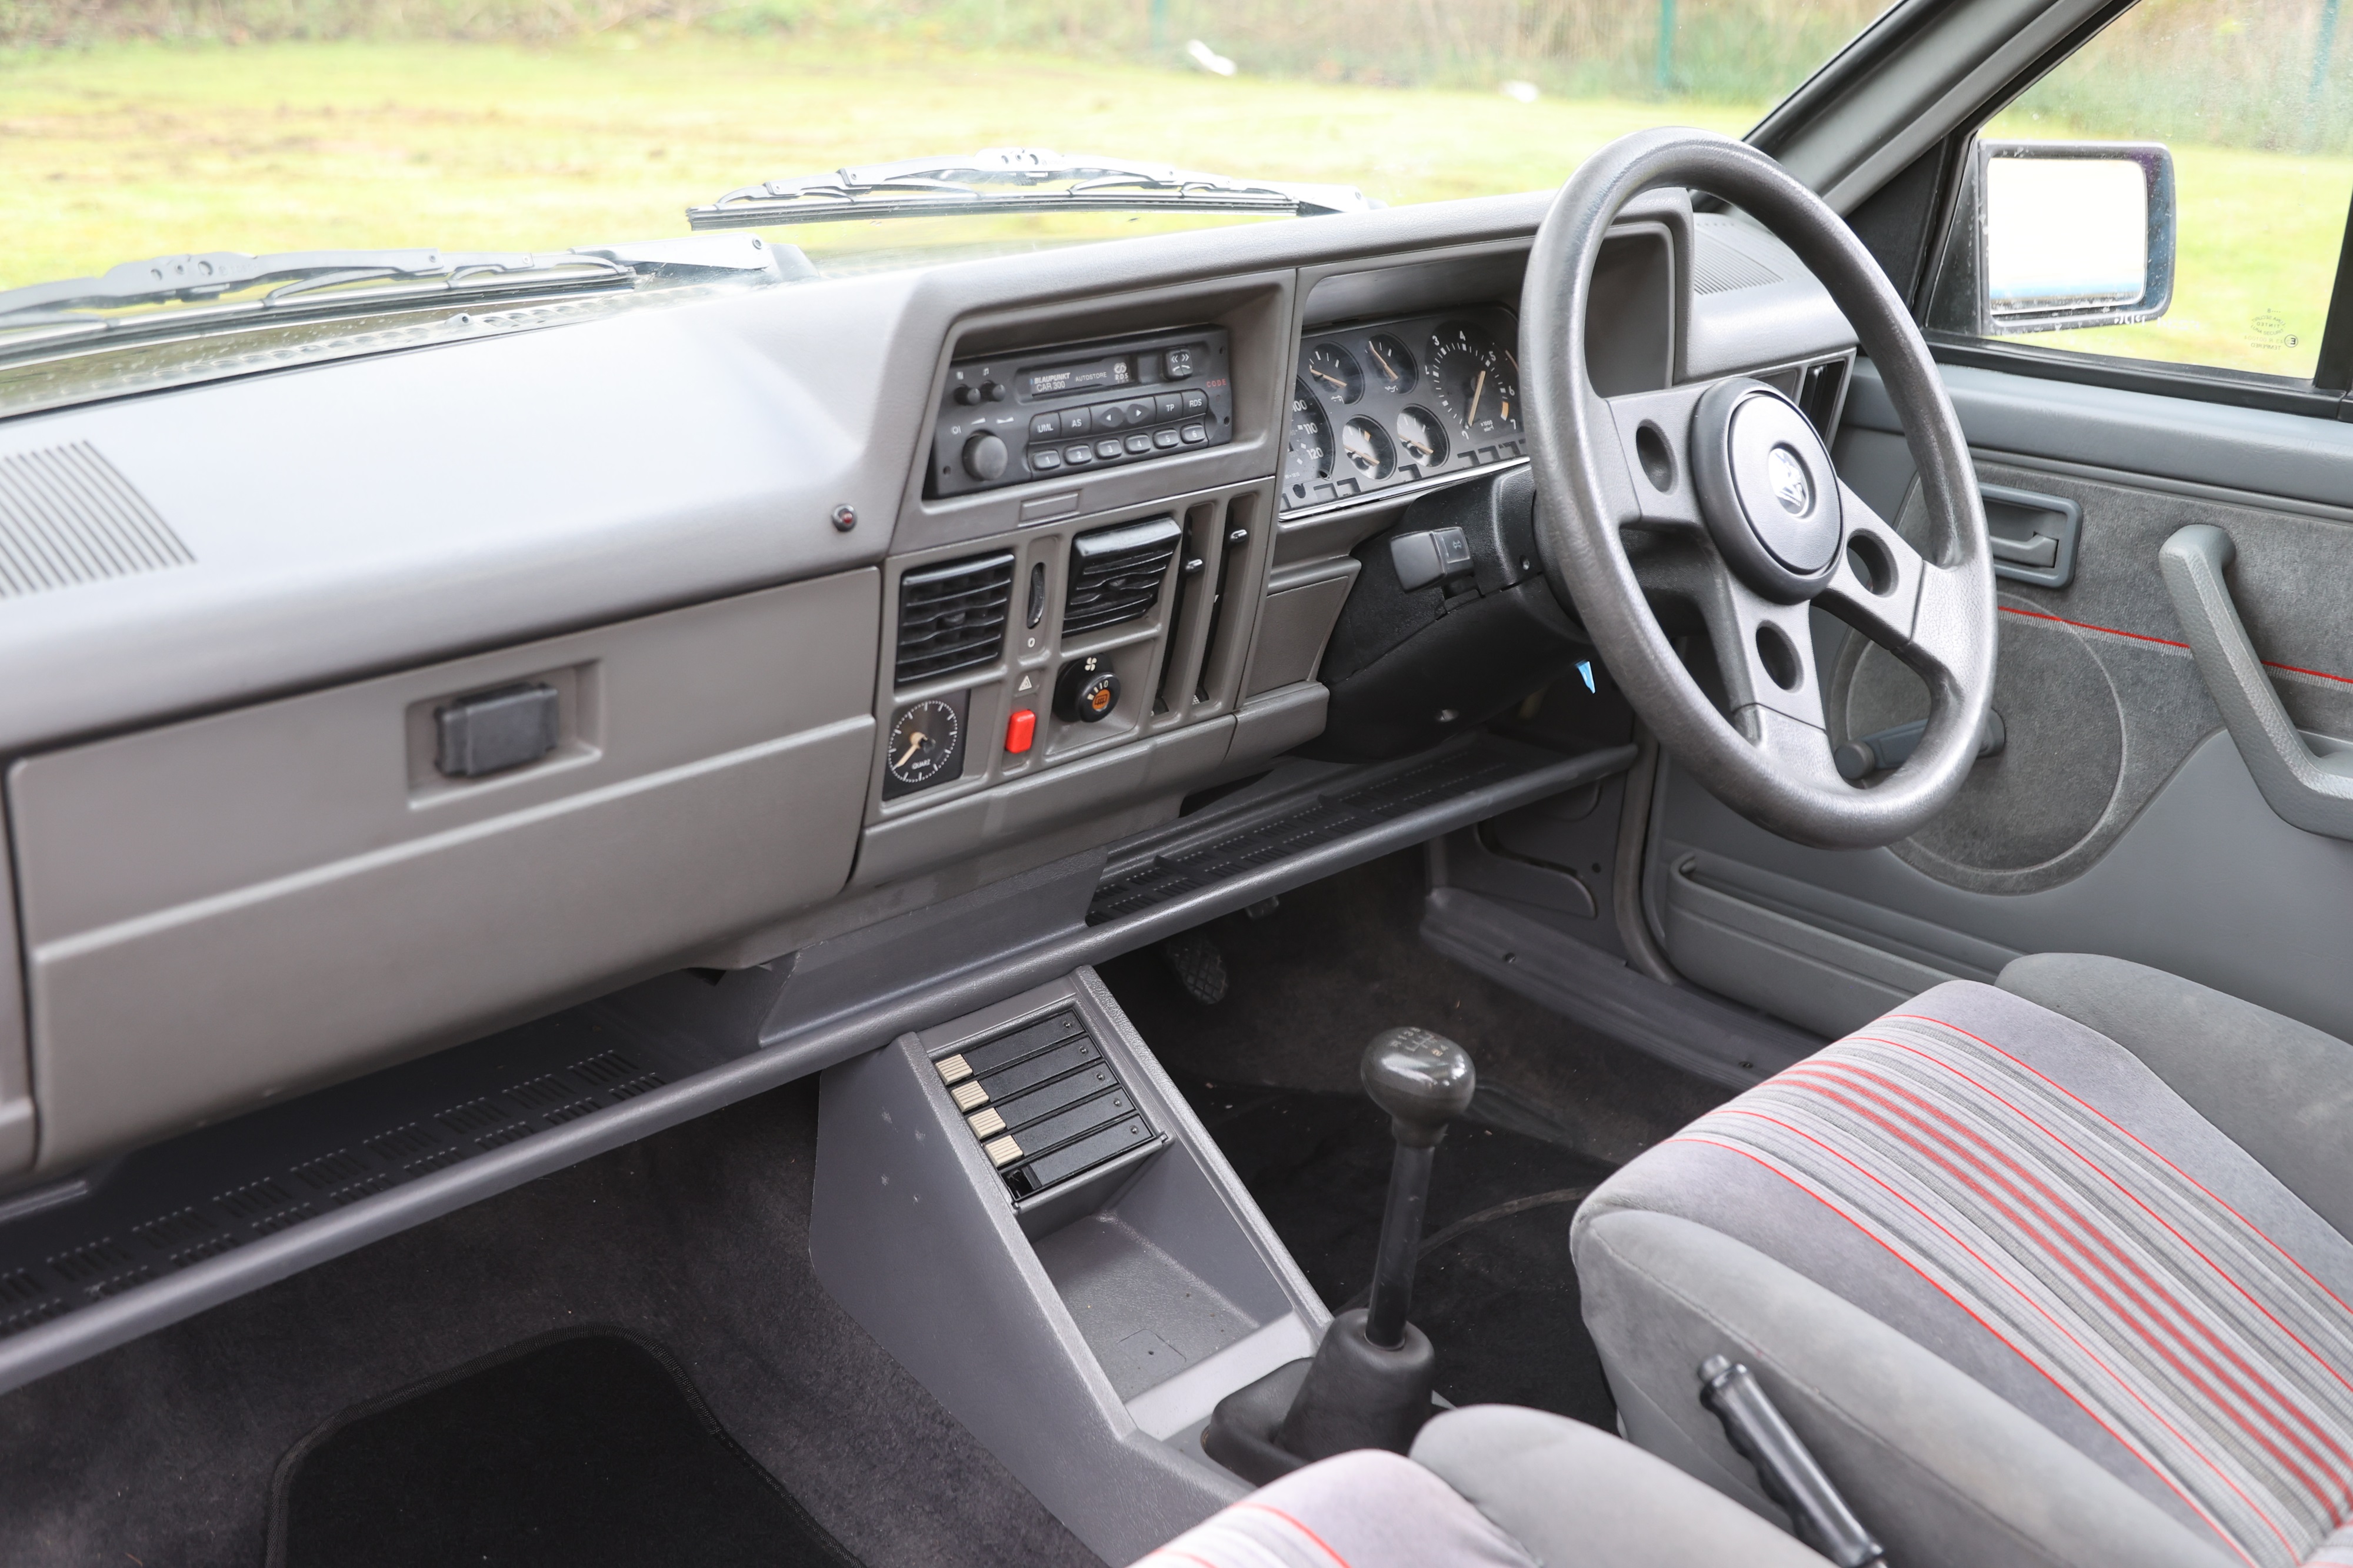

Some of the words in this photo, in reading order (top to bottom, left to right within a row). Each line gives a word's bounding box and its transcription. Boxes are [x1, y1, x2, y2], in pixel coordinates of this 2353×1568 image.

[1432, 335, 1439, 346] 3
[1459, 331, 1466, 341] 4
[1489, 351, 1496, 362] 5
[1034, 372, 1071, 385] BLAUPUNKT
[1075, 372, 1107, 382] AUTOSTORE
[1036, 383, 1052, 392] CAR
[1054, 381, 1065, 389] 300
[1207, 379, 1227, 388] CODE
[1509, 386, 1515, 396] 6
[1189, 399, 1202, 408] RDS
[1037, 423, 1054, 433] UML
[1072, 419, 1082, 428] AS
[1304, 422, 1318, 435] 110
[1510, 419, 1517, 430] 7
[1076, 451, 1082, 459] 2
[1307, 447, 1324, 460] 120
